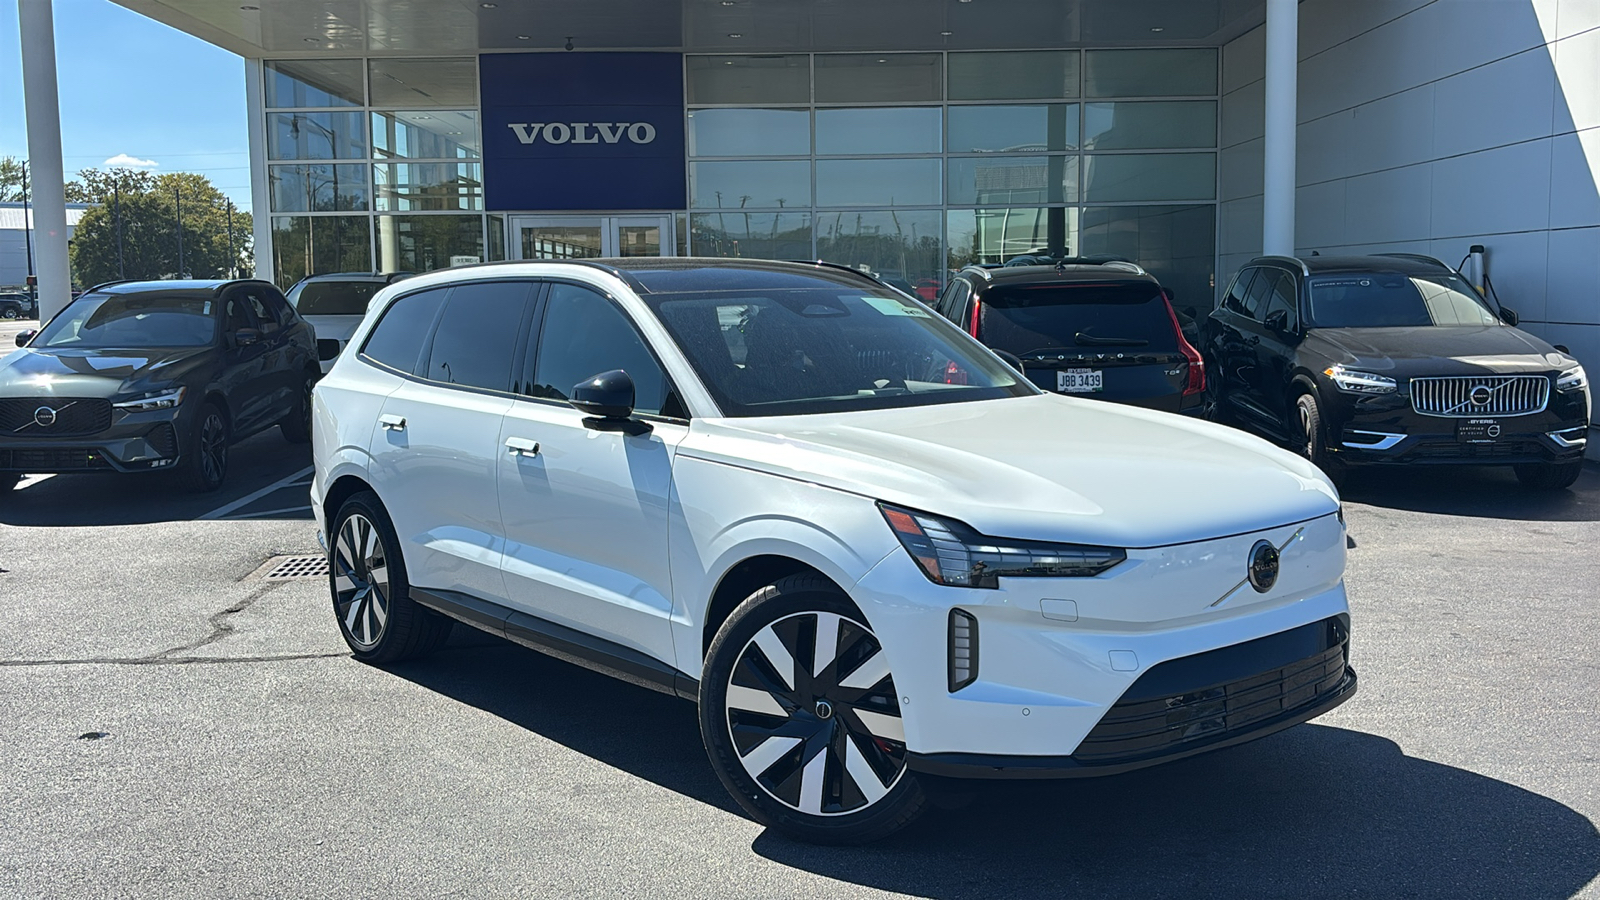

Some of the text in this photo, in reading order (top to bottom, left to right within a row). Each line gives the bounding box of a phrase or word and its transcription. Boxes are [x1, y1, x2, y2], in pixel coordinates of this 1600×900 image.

[507, 122, 656, 144] VOLVO
[1036, 353, 1124, 361] VOLVO
[1060, 374, 1101, 387] JBB 3439
[1255, 561, 1278, 571] VOLVO
